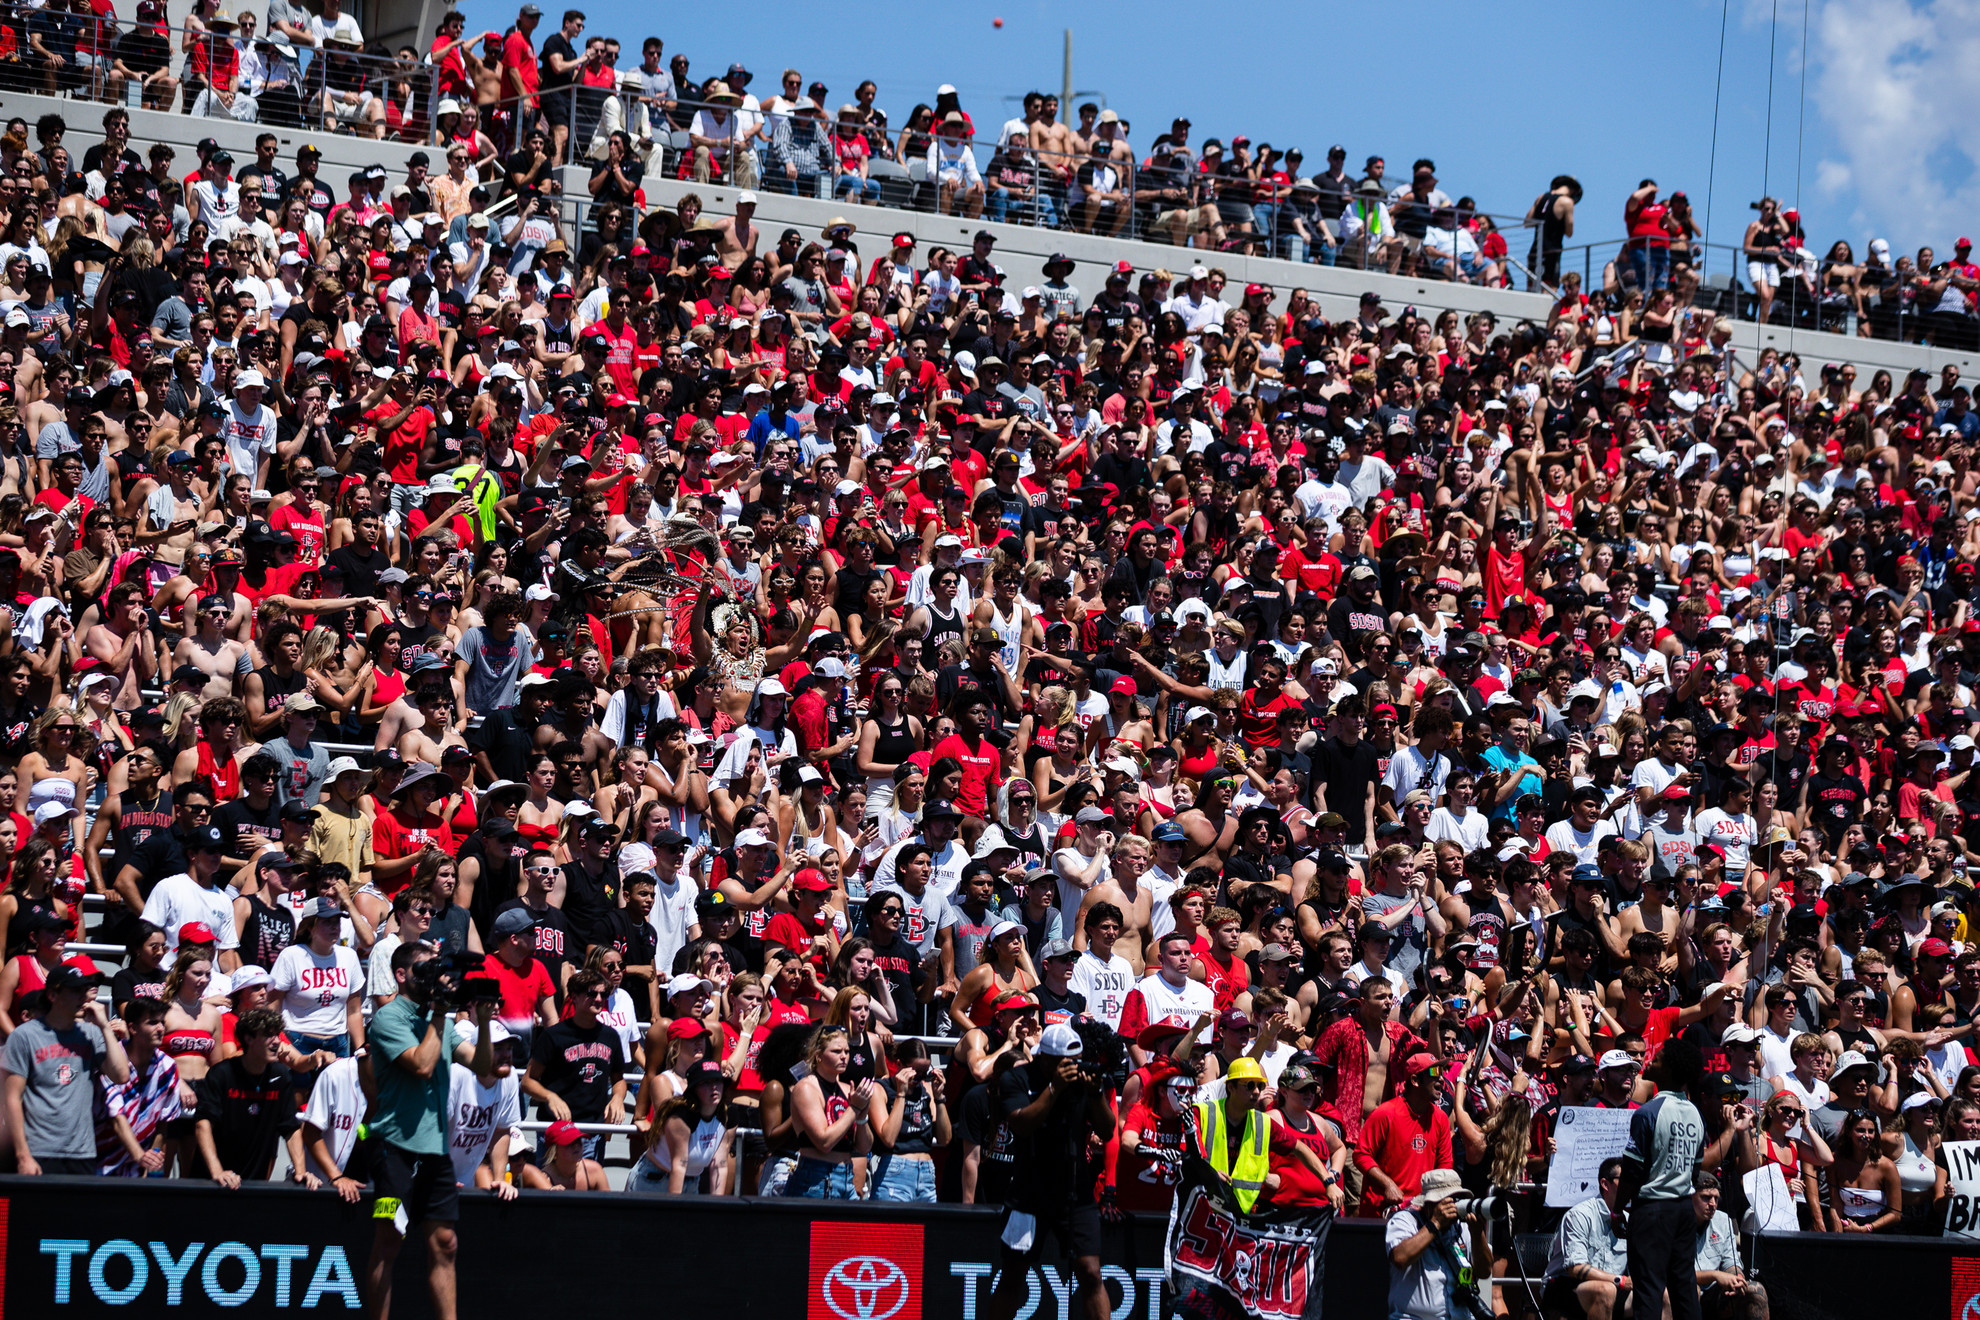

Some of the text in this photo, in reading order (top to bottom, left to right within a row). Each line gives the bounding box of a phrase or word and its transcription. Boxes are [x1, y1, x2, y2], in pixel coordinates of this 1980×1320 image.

[534, 926, 564, 956] DSU
[301, 966, 348, 991] SDSU
[1094, 972, 1126, 992] SDSU
[1670, 1121, 1697, 1138] CSC
[39, 1238, 362, 1309] TOYOTA
